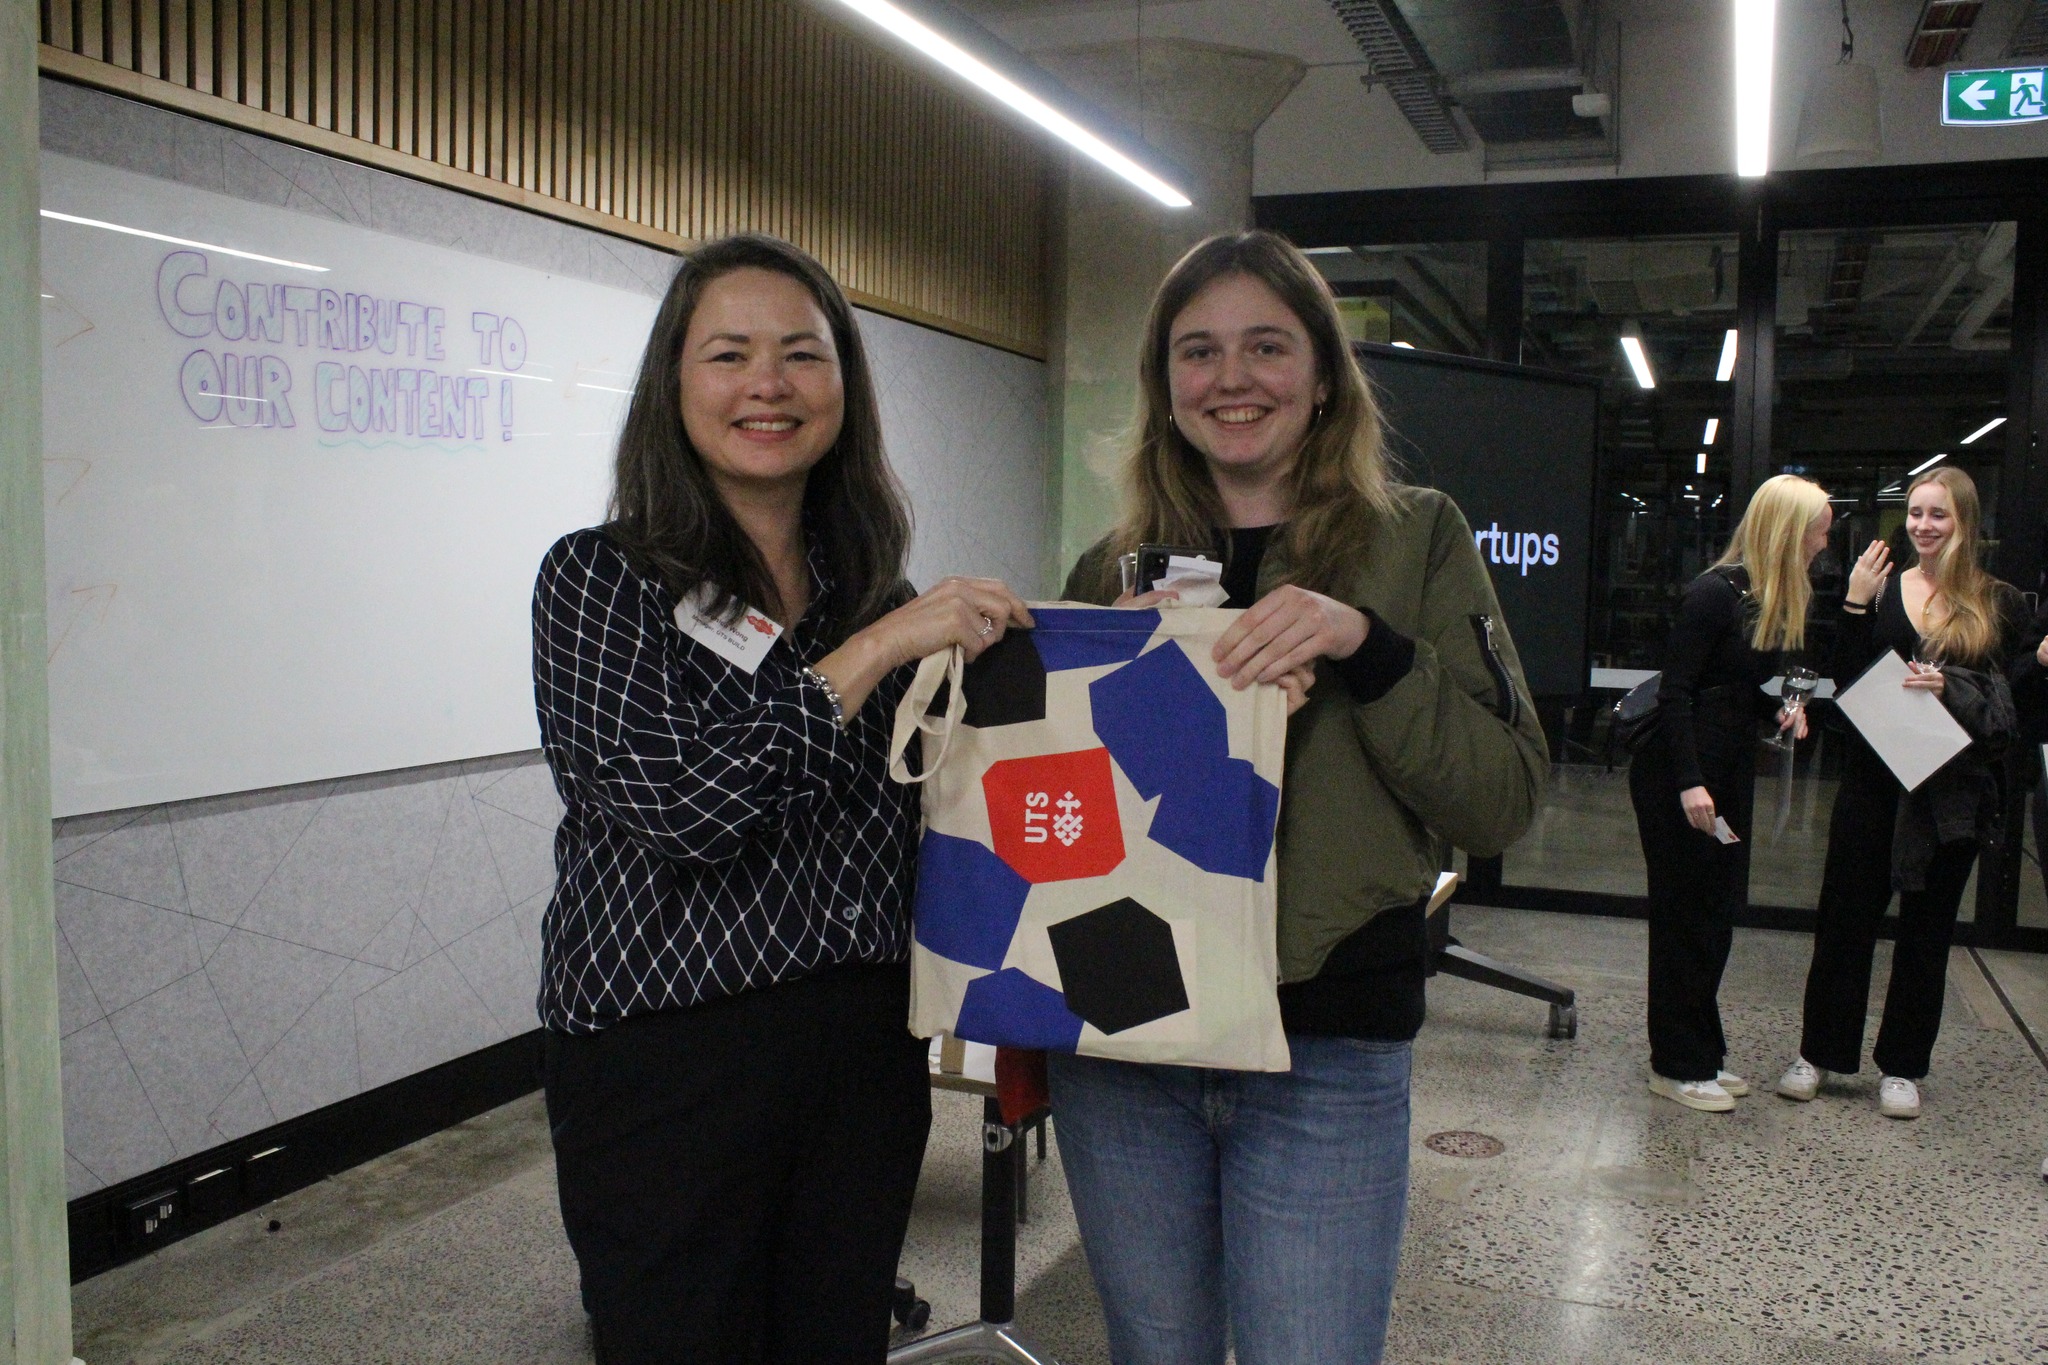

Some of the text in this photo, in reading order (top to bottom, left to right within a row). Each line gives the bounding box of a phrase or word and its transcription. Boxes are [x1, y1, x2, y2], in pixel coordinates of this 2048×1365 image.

[157, 251, 527, 371] CONTRIBUTE TO
[180, 349, 295, 428] OUR
[728, 638, 745, 650] BUILD
[729, 626, 749, 642] Wong
[1024, 791, 1049, 843] UTS
